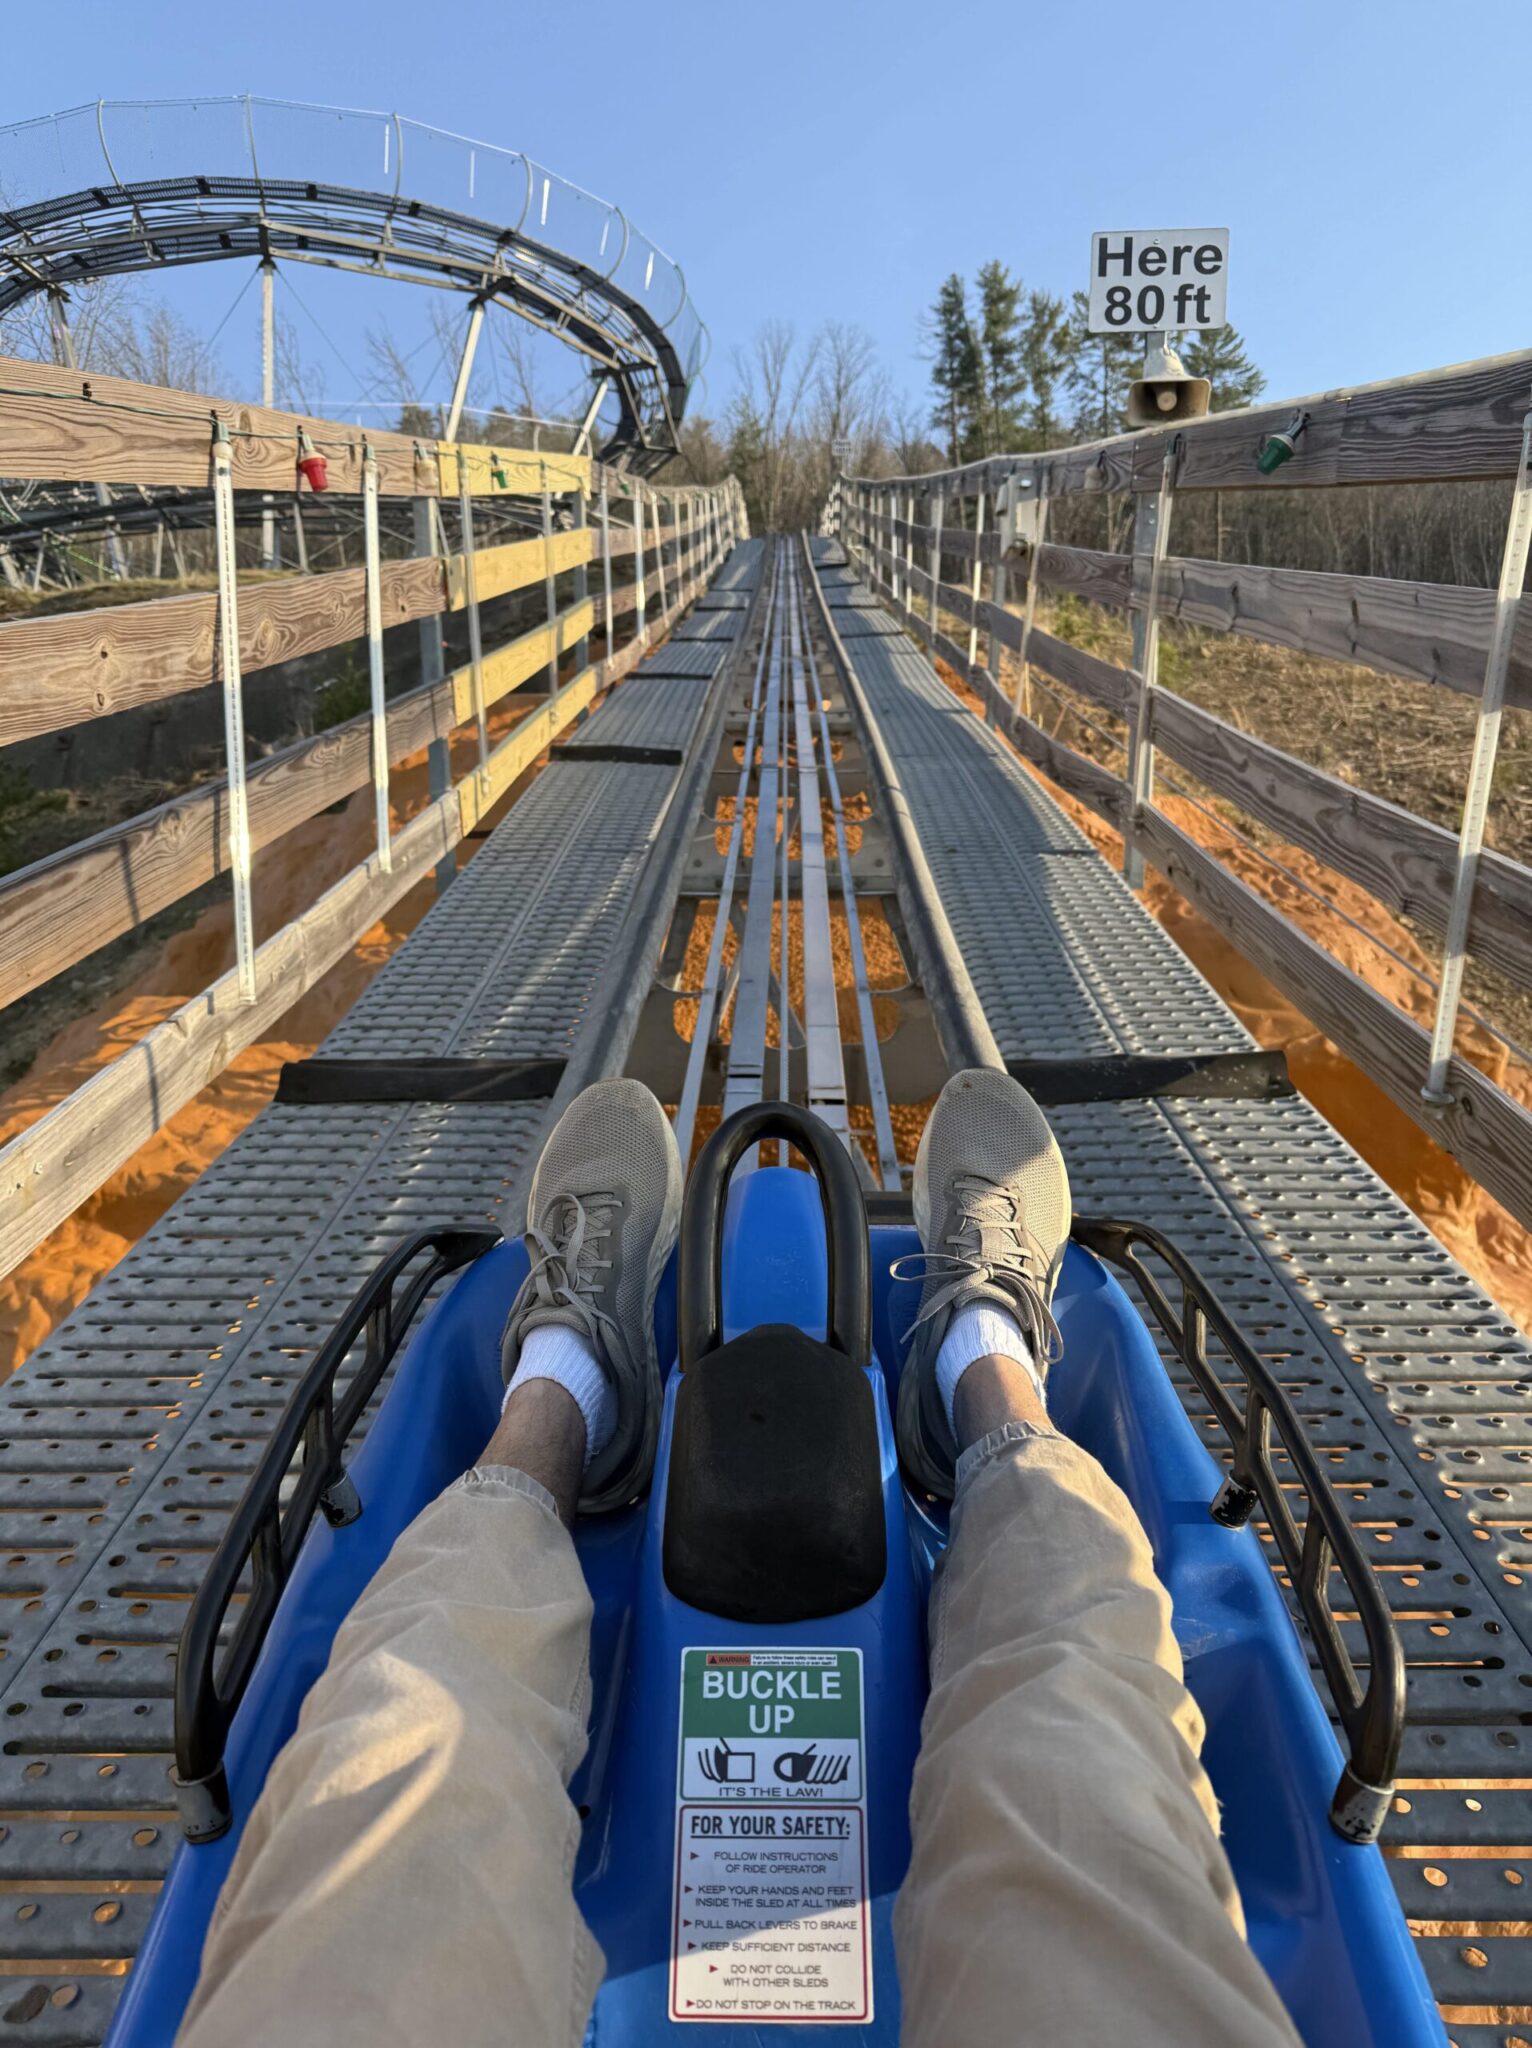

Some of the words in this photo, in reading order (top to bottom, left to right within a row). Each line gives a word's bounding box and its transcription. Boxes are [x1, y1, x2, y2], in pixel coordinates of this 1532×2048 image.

[1098, 236, 1223, 277] Here
[1104, 285, 1165, 325] 80
[1173, 283, 1211, 324] ft
[718, 1656, 751, 1664] WARNING
[702, 1670, 842, 1699] BUCKLE
[749, 1704, 795, 1734] UP
[719, 1787, 746, 1797] IT'S
[750, 1787, 781, 1797] THE
[786, 1787, 823, 1797] LAW!
[691, 1815, 723, 1834] FOR
[729, 1816, 776, 1835] YOUR
[782, 1816, 851, 1836] SAFETY:
[714, 1851, 759, 1861] FOLLOW
[760, 1851, 839, 1861] INSTRUCTIONS
[725, 1864, 740, 1873] OF
[743, 1864, 767, 1874] RIDE
[769, 1864, 826, 1874] OPERATOR
[698, 1885, 727, 1894] KEEP
[728, 1885, 759, 1895] YOUR
[761, 1886, 799, 1895] HANDS
[801, 1886, 825, 1895] AND
[827, 1886, 854, 1895] FEET
[696, 1898, 729, 1908] INSIDE
[731, 1898, 754, 1908] THE
[756, 1898, 785, 1908] SLED
[786, 1899, 801, 1908] AT
[801, 1899, 823, 1908] ALL
[825, 1899, 857, 1909] TIMES
[694, 1920, 725, 1929] PULL
[726, 1920, 756, 1930] BACK
[758, 1920, 801, 1930] LEVERS
[803, 1920, 818, 1930] TO
[820, 1920, 858, 1930] BRAKE
[701, 1942, 730, 1951] KEEP
[732, 1942, 795, 1952] SUFFICIENT
[797, 1943, 851, 1952] DISTANCE
[730, 1964, 747, 1974] DO
[749, 1965, 773, 1974] NOT
[775, 1965, 822, 1975] COLLIDE
[724, 1977, 750, 1987] WITH
[752, 1978, 790, 1987] OTHER
[793, 1978, 829, 1988] SLEDS
[696, 1999, 712, 2009] DO
[715, 2000, 738, 2009] NOT
[742, 2000, 772, 2009] STOP
[773, 2000, 791, 2010] ON
[793, 2000, 815, 2010] THE
[818, 2000, 856, 2010] TRACK
